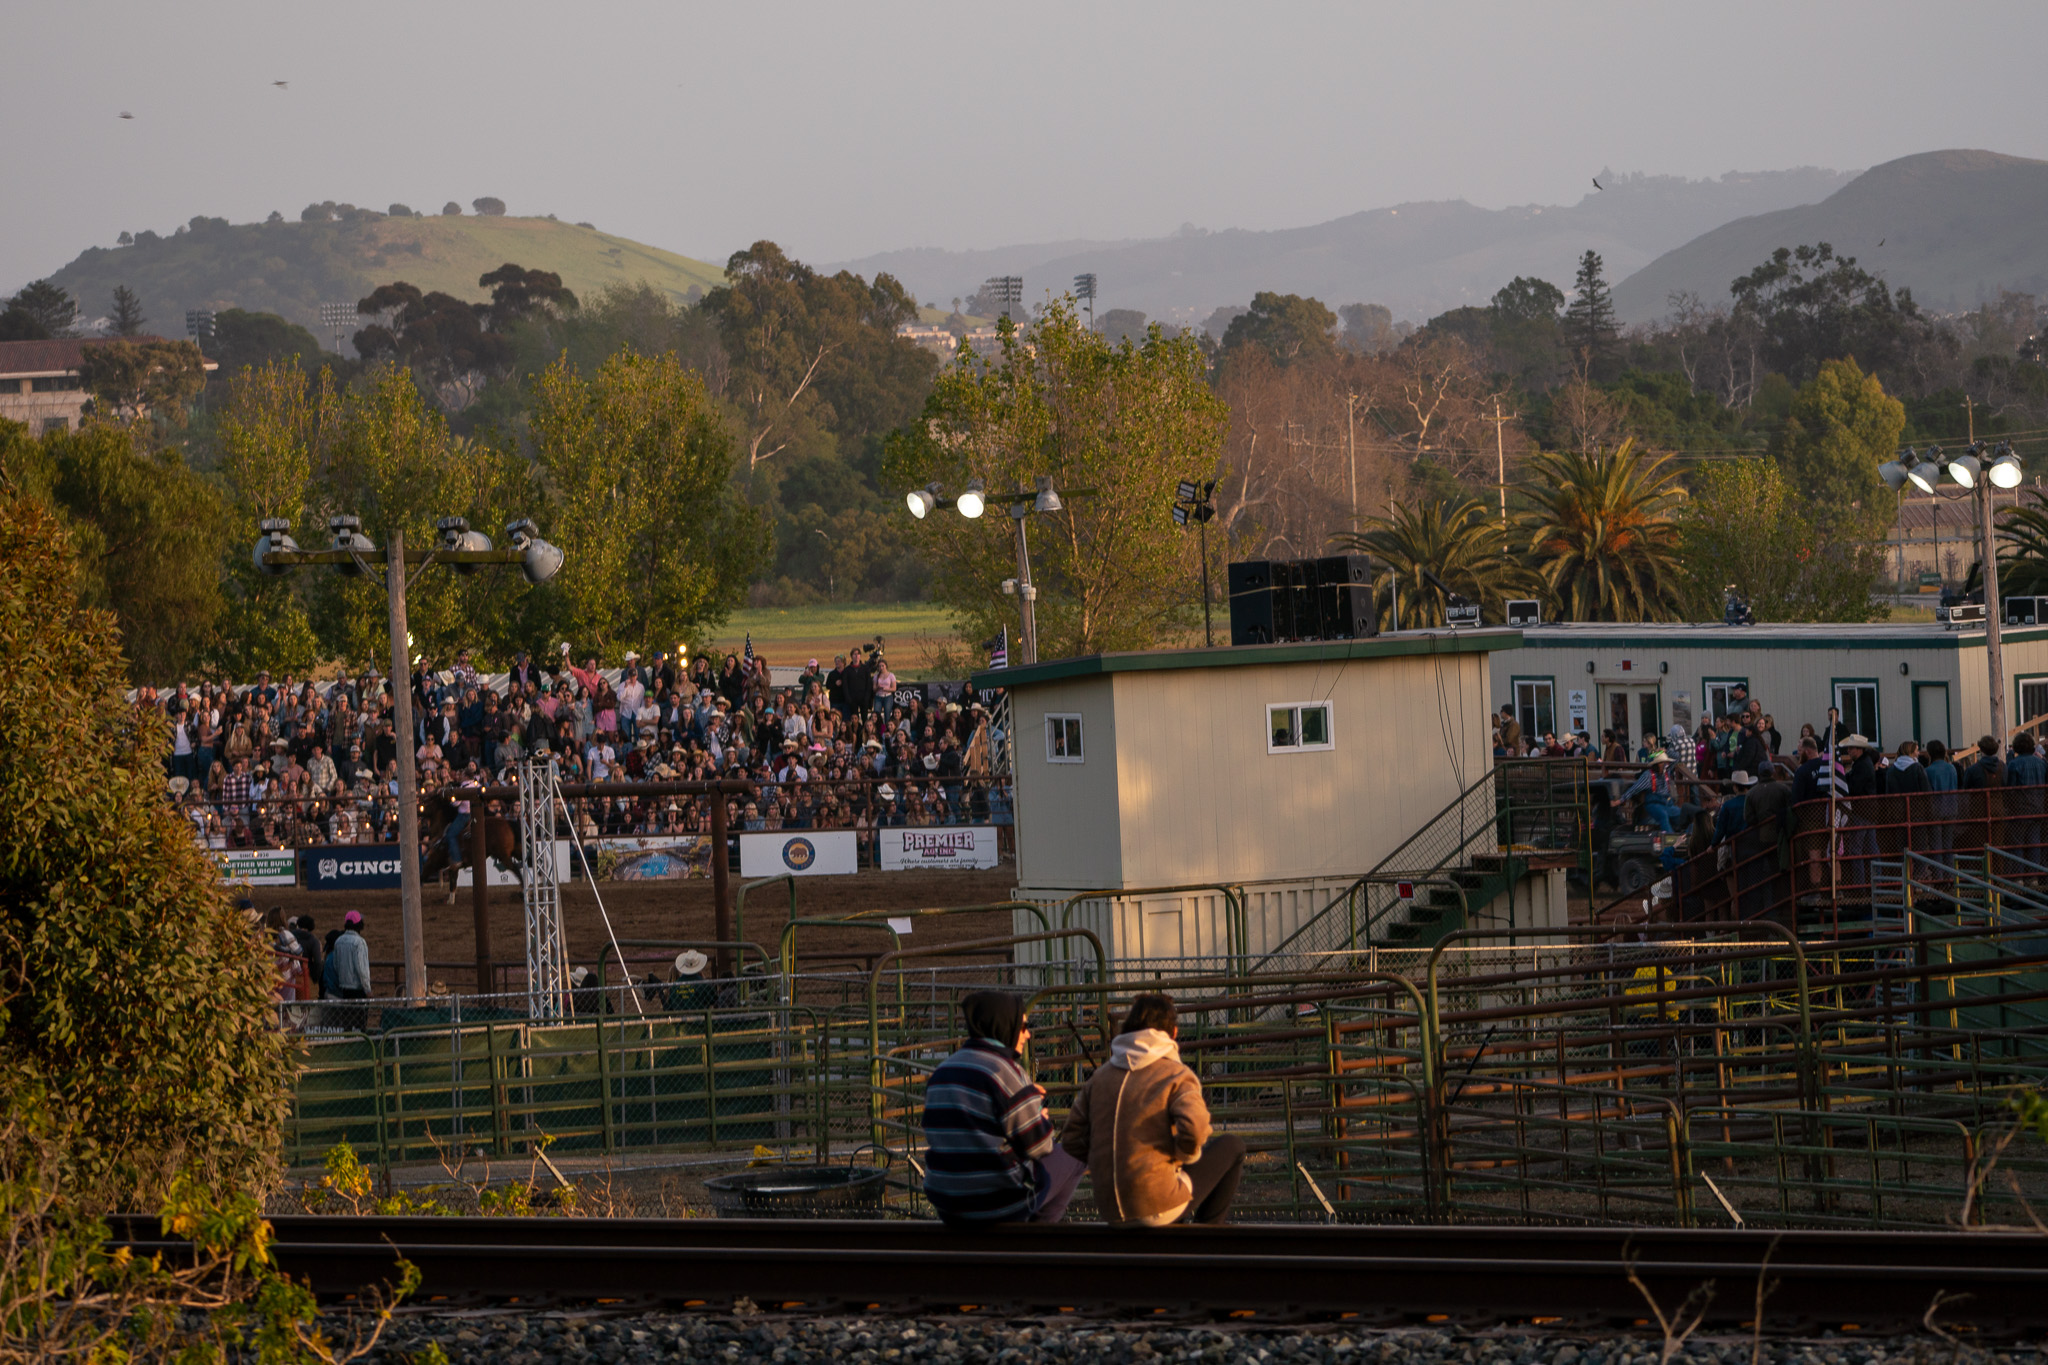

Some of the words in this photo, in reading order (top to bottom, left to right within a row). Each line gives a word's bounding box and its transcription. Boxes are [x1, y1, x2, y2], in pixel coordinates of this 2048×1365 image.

[894, 690, 922, 704] 805
[903, 830, 975, 852] PREMIER
[256, 860, 269, 868] WE
[270, 859, 293, 867] BUILD
[259, 867, 282, 875] RIGHT
